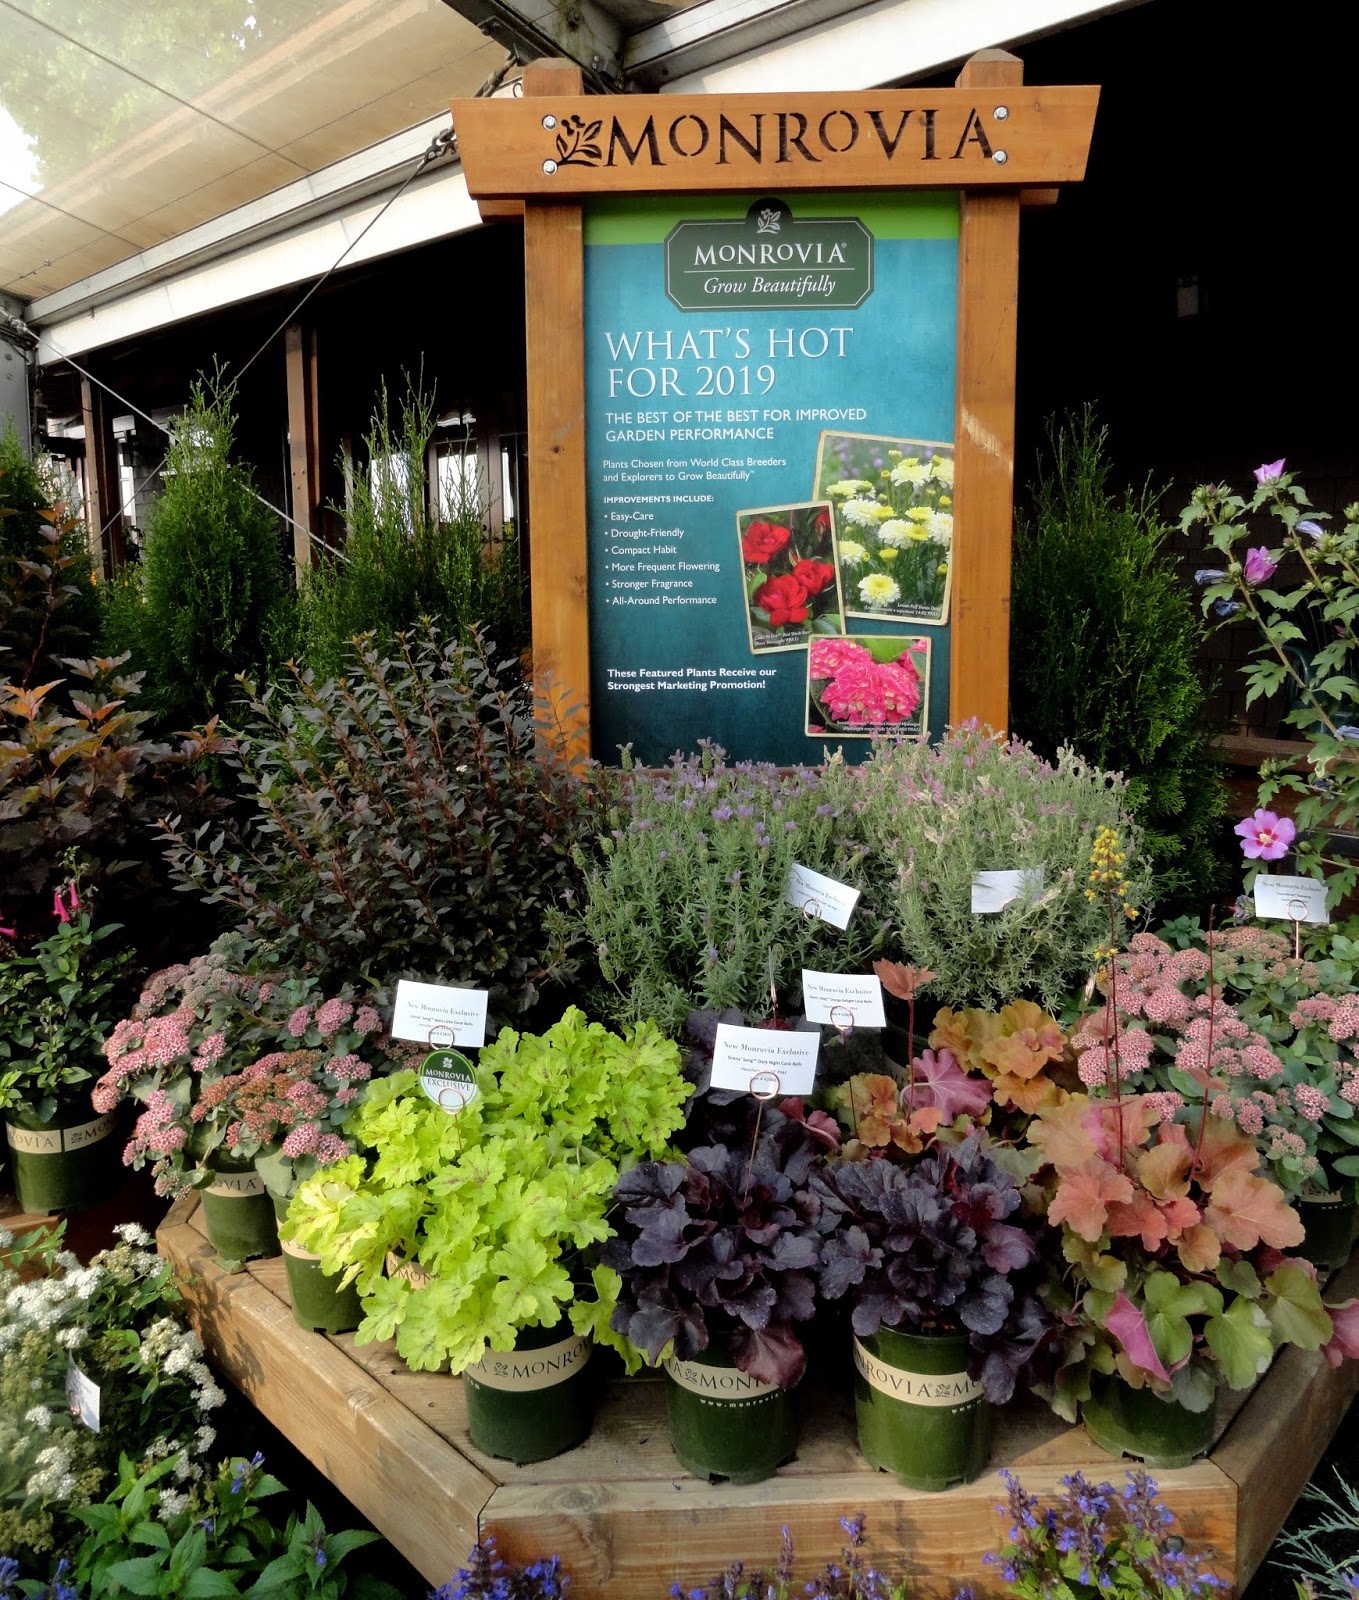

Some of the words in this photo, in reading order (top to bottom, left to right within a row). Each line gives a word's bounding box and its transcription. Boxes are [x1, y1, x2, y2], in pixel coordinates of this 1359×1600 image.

[602, 107, 995, 167] MONROVIA
[703, 277, 746, 294] Grow
[751, 275, 836, 297] Beautifully
[604, 328, 751, 361] WHAT'S
[768, 327, 854, 358] HOT
[608, 367, 685, 398] FOR
[696, 365, 776, 396] 2019
[605, 412, 633, 425] THE
[637, 411, 669, 424] BEST
[673, 411, 693, 423] OF
[695, 410, 722, 423] THE
[727, 410, 759, 422] BEST
[763, 409, 791, 422] FOR
[796, 408, 867, 421] IMPROVED
[605, 429, 665, 442] GARDEN
[670, 427, 774, 441] PERFORMANCE
[603, 460, 628, 469] Plants
[631, 459, 664, 469] Chosen
[666, 458, 688, 468] from
[690, 458, 719, 467] World
[721, 458, 744, 467] Class
[747, 457, 787, 467] Breeders
[603, 473, 619, 482] and
[621, 472, 663, 484] Explorers
[665, 472, 675, 481] to
[678, 471, 704, 481] Grow
[603, 495, 671, 504] IMPROVEMENTS
[673, 495, 714, 503] INCLUDE:
[610, 512, 654, 523] Easy-Care
[611, 528, 685, 540] Drought-Friendly
[611, 546, 651, 557] Compact
[653, 545, 678, 555] Habit
[611, 562, 635, 572] More
[637, 562, 676, 573] Frequent
[678, 561, 720, 573] Flowering
[611, 579, 649, 591] Stronger
[651, 579, 694, 590] Fragrance
[612, 596, 660, 605] All-Around
[662, 595, 717, 605] Performance
[607, 668, 637, 678] These
[639, 668, 684, 678] Featured
[686, 668, 717, 677] Plants
[719, 667, 757, 677] Receive
[759, 668, 777, 676] our
[607, 681, 655, 692] Strongest
[657, 681, 707, 692] Marketing
[710, 680, 766, 690] Promotion!
[450, 1007, 480, 1018] Exclusive
[723, 1041, 738, 1049] New
[740, 1043, 775, 1054] Monrovia
[777, 1047, 810, 1056] Exclusive
[425, 1068, 472, 1082] MONROVIA
[427, 1078, 471, 1091] EXCLUSIVE
